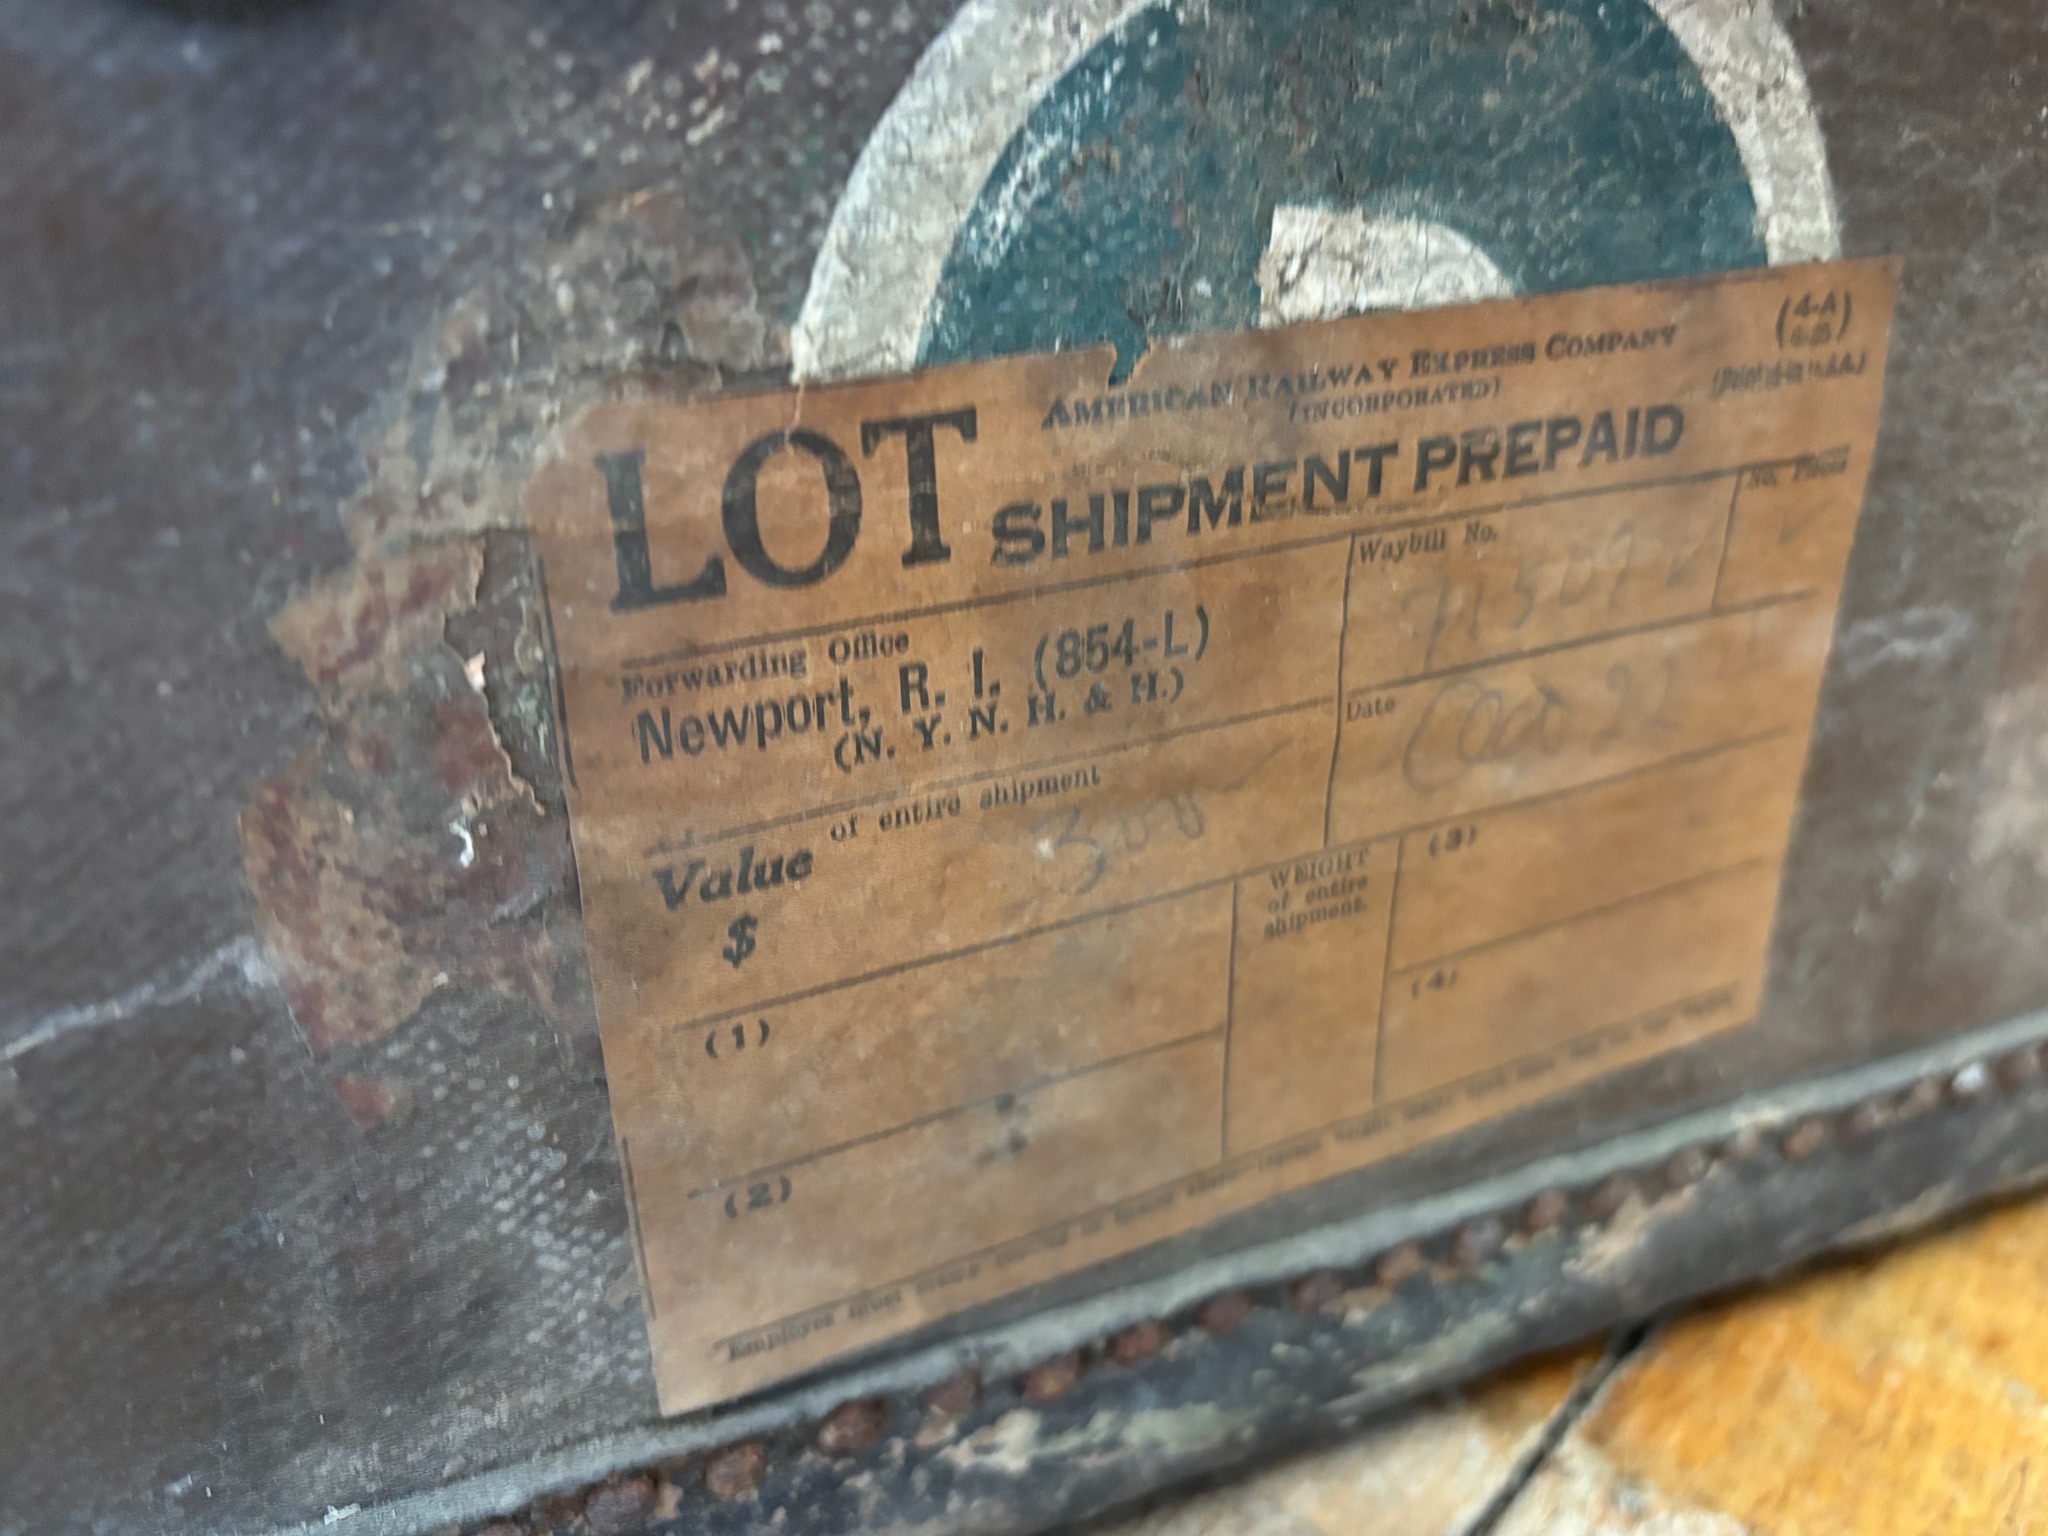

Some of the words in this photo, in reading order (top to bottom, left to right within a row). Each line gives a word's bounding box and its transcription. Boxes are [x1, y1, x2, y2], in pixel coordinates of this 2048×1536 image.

[1249, 358, 1398, 400] RAILWAY
[1410, 342, 1536, 377] EXPRESS
[1544, 324, 1678, 362] COMPANY
[1289, 375, 1501, 424] (INCORPORATED)
[594, 404, 978, 615] LOT
[991, 441, 1399, 566] SHIPMENT
[1413, 403, 1686, 494] PREPAID
[1359, 527, 1446, 567] Waybill
[1463, 521, 1497, 547] No.
[622, 650, 807, 701] Forwarding
[828, 630, 909, 664] Office
[634, 676, 870, 766] Newport,
[899, 660, 946, 715] R.
[971, 647, 1000, 698] I.
[1034, 604, 1209, 691] (854-L)
[834, 725, 896, 774] (N.
[913, 713, 951, 752] Y.
[969, 702, 1008, 740] N.
[1027, 690, 1066, 727] H.
[1083, 680, 1112, 715] &
[1130, 666, 1184, 704] H.)
[1346, 696, 1396, 723] Date
[829, 817, 860, 844] of
[877, 793, 962, 834] entire
[979, 765, 1101, 809] shipment
[651, 845, 813, 912] Value
[1268, 889, 1290, 914] of
[1304, 874, 1369, 905] entire
[1270, 846, 1369, 891] WEIGHT
[722, 913, 758, 968] $
[704, 1017, 771, 1059] (1)
[724, 1176, 792, 1219] (2)
